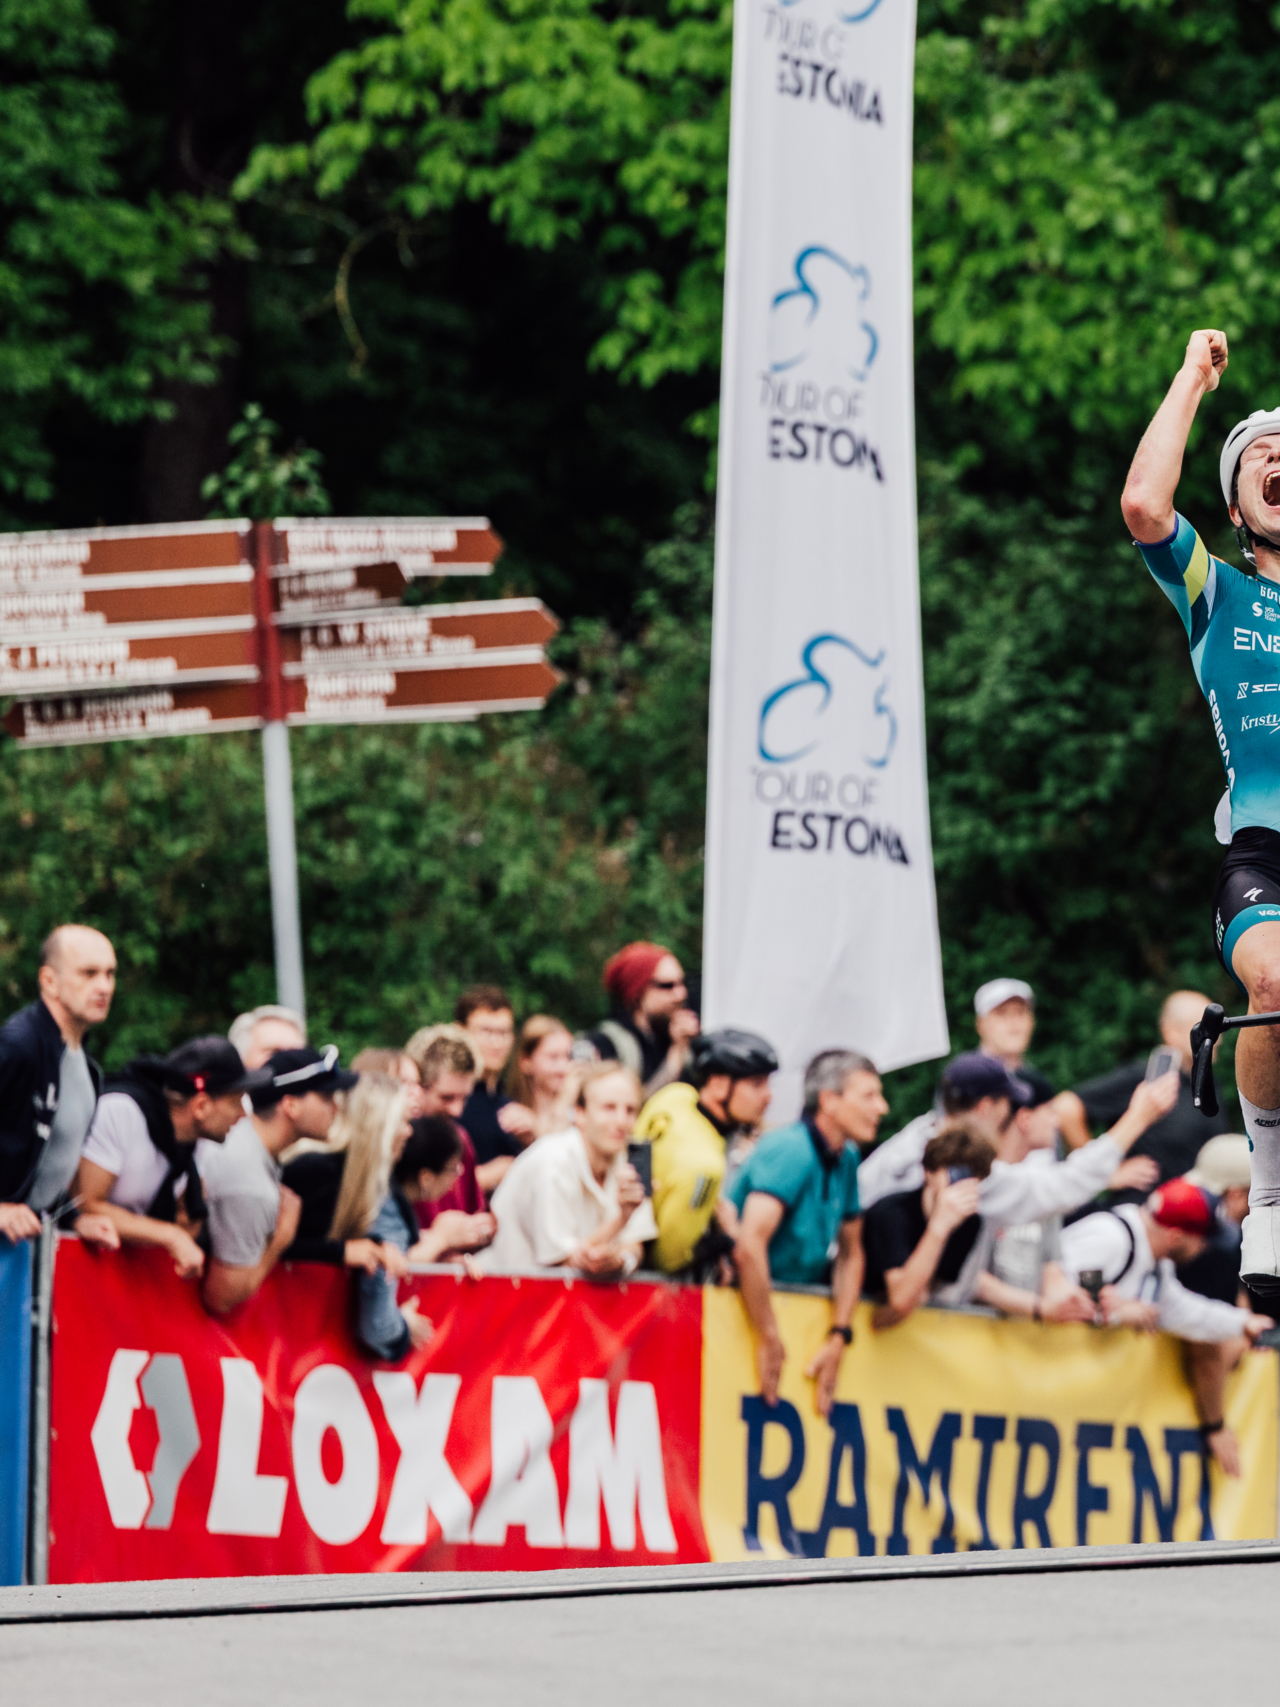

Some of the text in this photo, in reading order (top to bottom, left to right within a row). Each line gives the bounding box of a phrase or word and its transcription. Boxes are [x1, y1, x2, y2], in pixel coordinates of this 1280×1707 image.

[778, 52, 885, 126] ESTONA
[769, 417, 885, 484] ESTON
[749, 765, 834, 807] OUR
[206, 1355, 678, 1554] LOXAM
